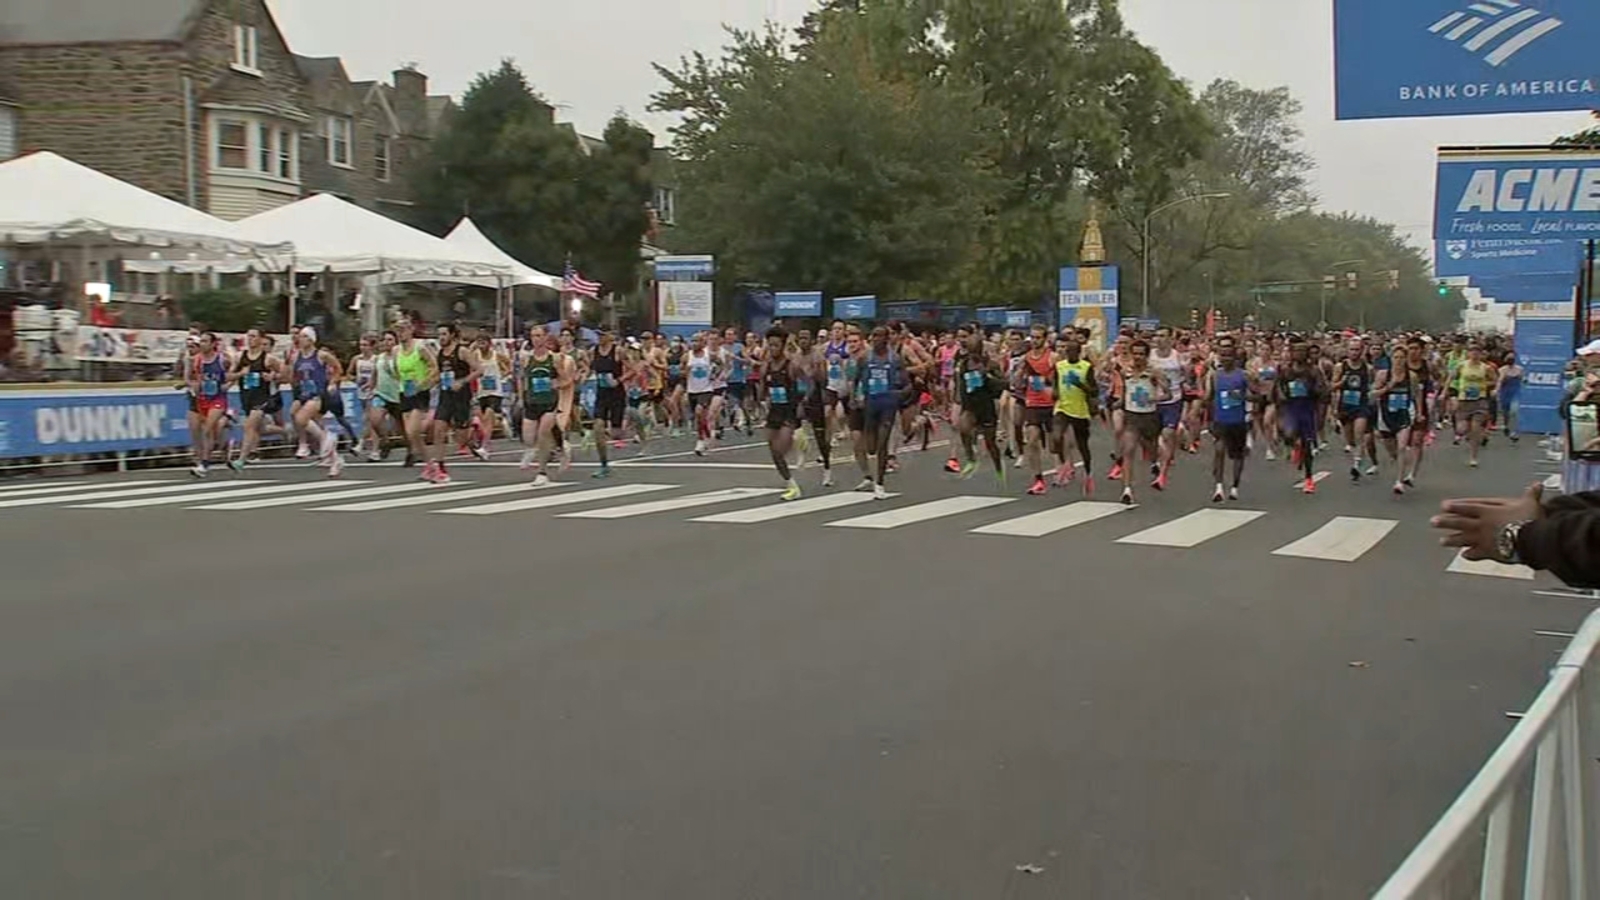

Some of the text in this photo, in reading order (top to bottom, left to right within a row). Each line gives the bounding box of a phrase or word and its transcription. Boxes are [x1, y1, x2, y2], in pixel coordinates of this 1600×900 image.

[1400, 79, 1594, 100] BANK OF AMERICA
[1455, 168, 1600, 212] ACME
[1061, 292, 1116, 305] TEN MILER
[36, 404, 167, 444] DUNKIN'
